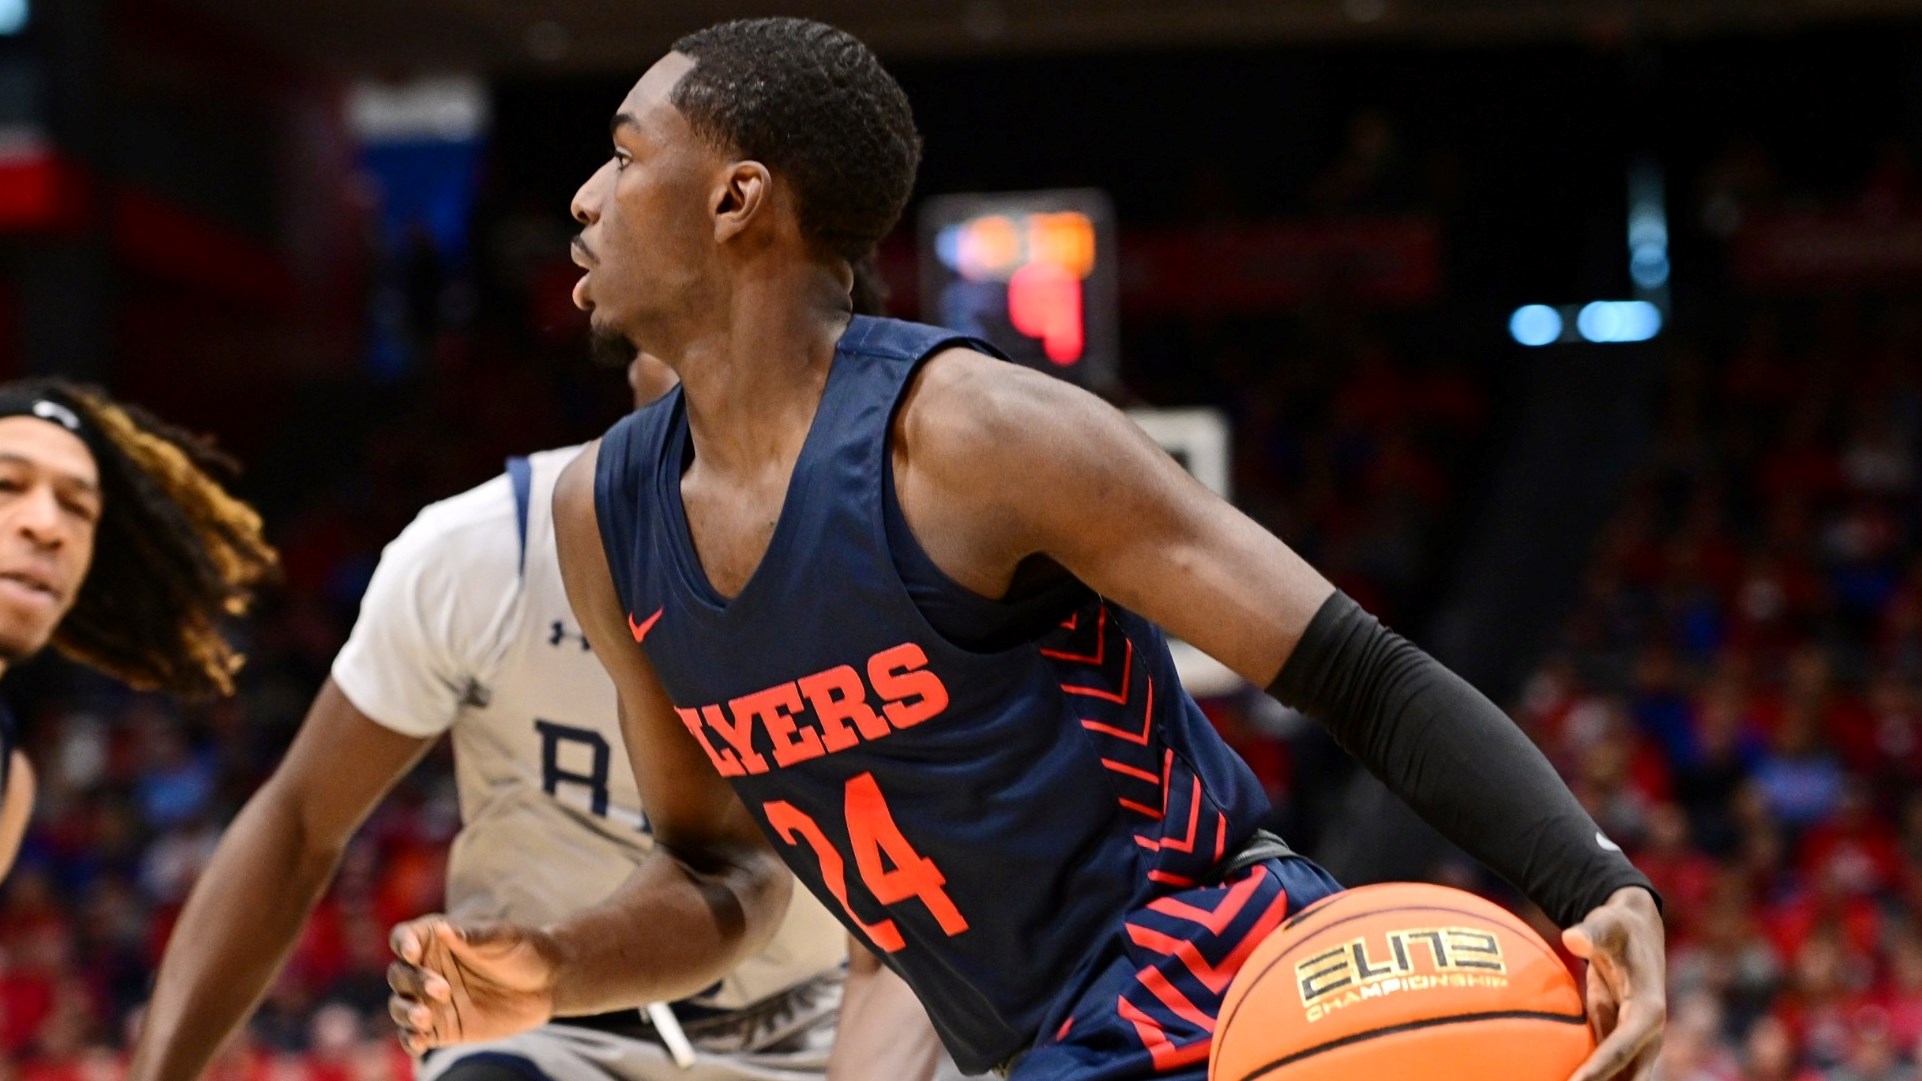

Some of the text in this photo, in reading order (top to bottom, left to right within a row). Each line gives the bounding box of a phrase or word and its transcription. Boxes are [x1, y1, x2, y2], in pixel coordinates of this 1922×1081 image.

[674, 642, 949, 777] LYERS
[763, 771, 969, 953] 24
[1295, 926, 1506, 1008] ELITE
[1306, 972, 1508, 1023] CHAMPIONSHIP
